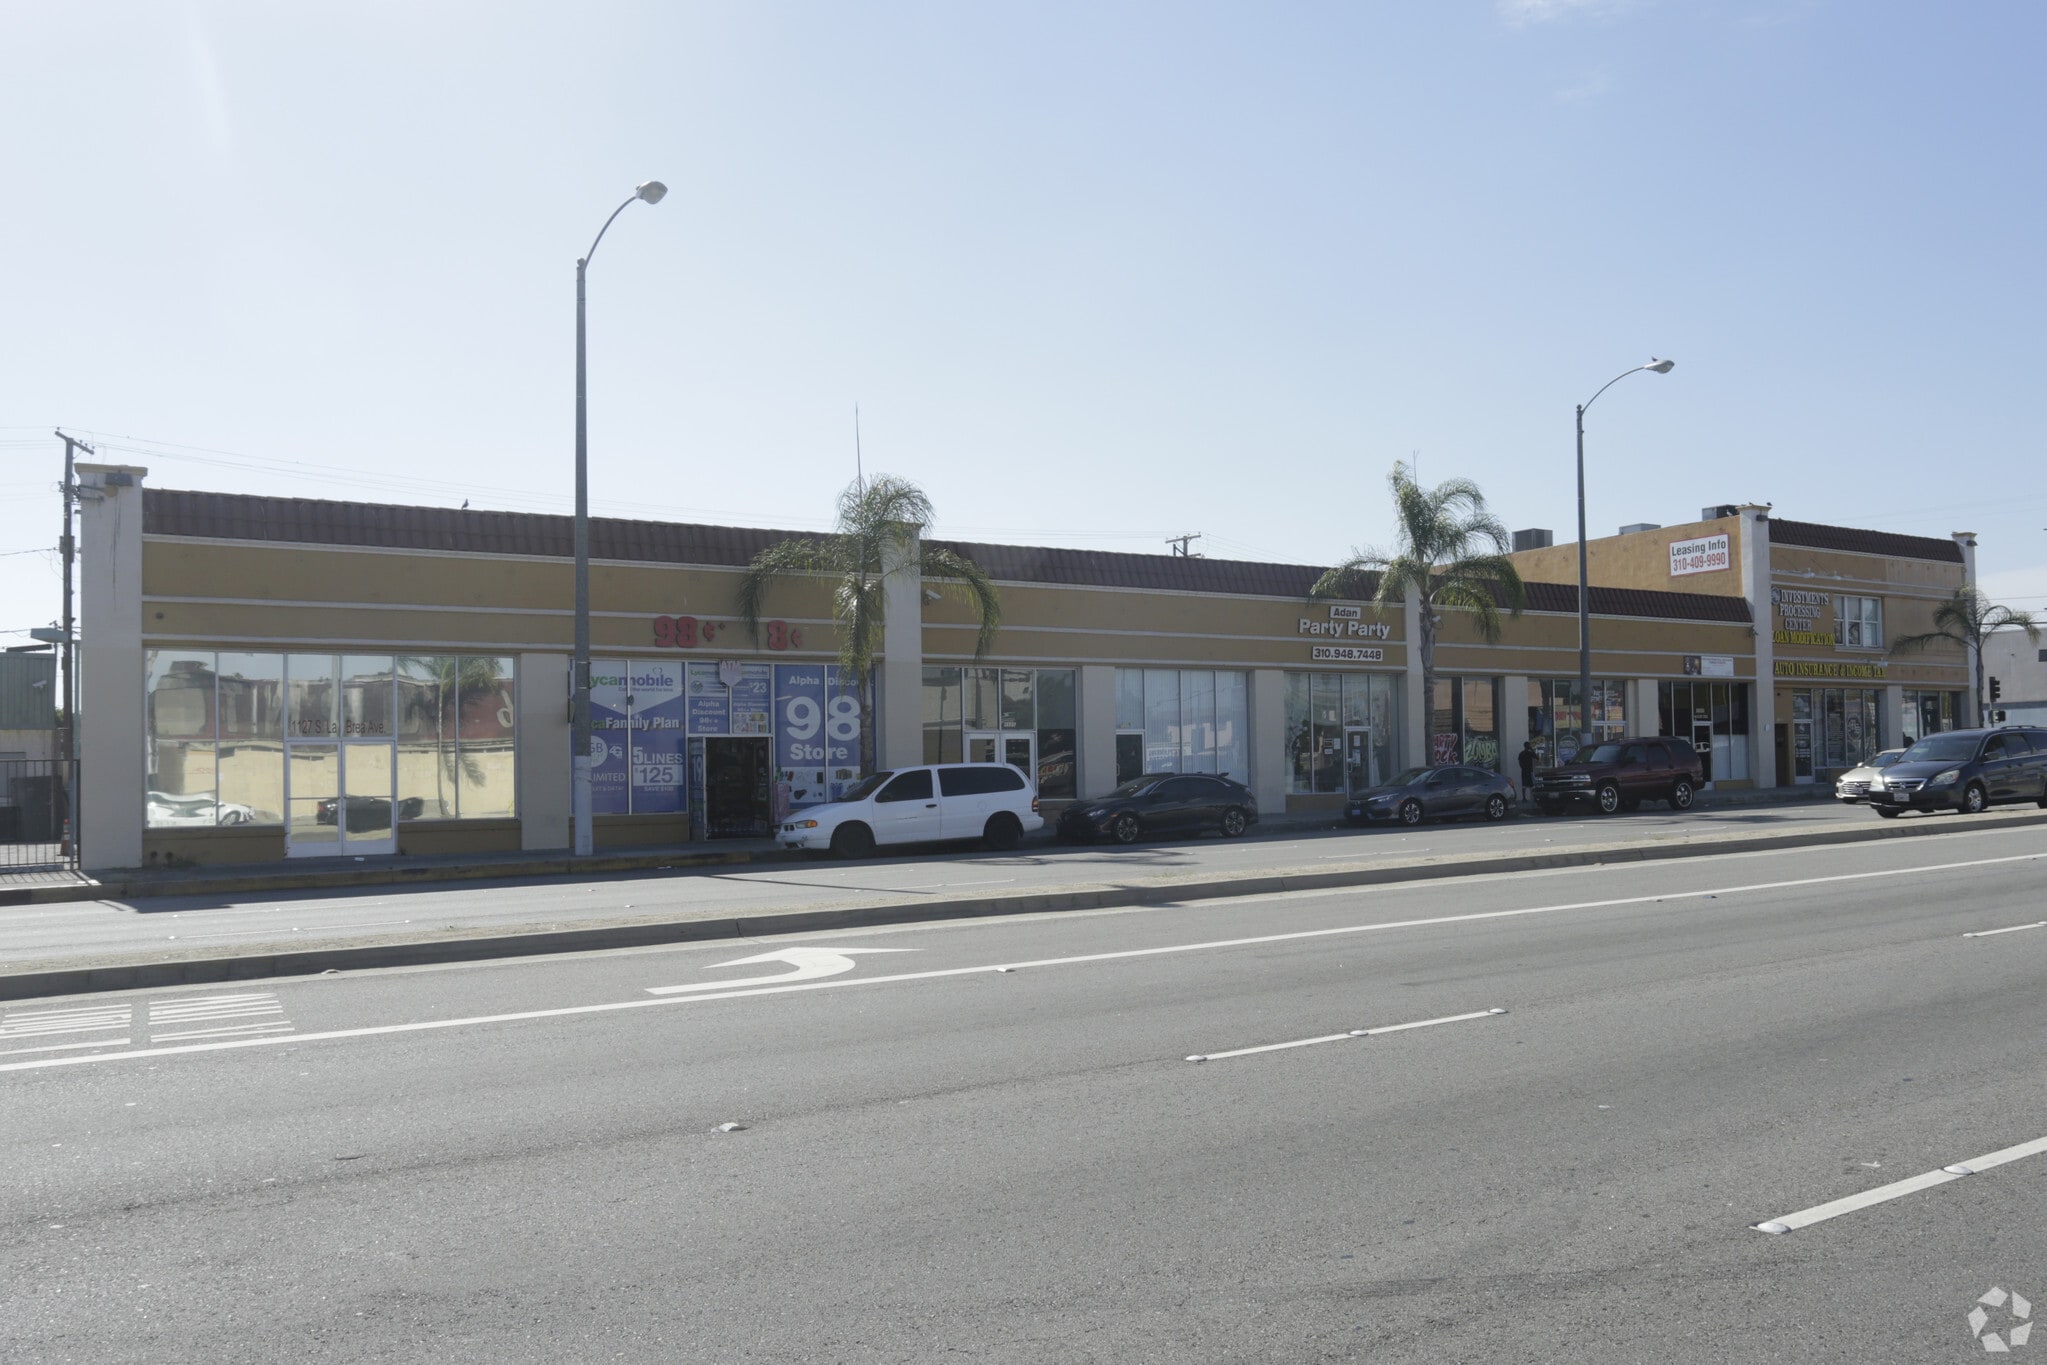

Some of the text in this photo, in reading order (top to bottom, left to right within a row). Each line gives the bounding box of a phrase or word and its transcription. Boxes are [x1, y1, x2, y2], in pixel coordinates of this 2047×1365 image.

[1672, 539, 1727, 557] Leasing Info
[1672, 551, 1726, 572] 310-409-9990
[1780, 589, 1829, 605] INVESTMENTS
[1333, 607, 1359, 618] Adan
[1779, 603, 1821, 619] PROCESSING
[1299, 617, 1391, 640] Party Party
[1784, 617, 1812, 632] CENTER
[1314, 648, 1381, 660] 310.948.7448
[1774, 661, 1795, 675] AUTO
[1796, 662, 1838, 677] INSURANCE
[1847, 664, 1873, 678] INCOME
[1873, 664, 1887, 678] TAX
[591, 673, 674, 688] ycamobile
[788, 675, 820, 687] Alpha
[697, 700, 720, 708] Alpha
[691, 708, 726, 716] Discount
[786, 695, 861, 741] 98
[292, 719, 311, 733] 1127
[316, 719, 322, 733] S
[327, 720, 337, 733] La
[346, 719, 365, 733] Brea
[652, 716, 680, 729] Plan
[789, 743, 849, 761] Store
